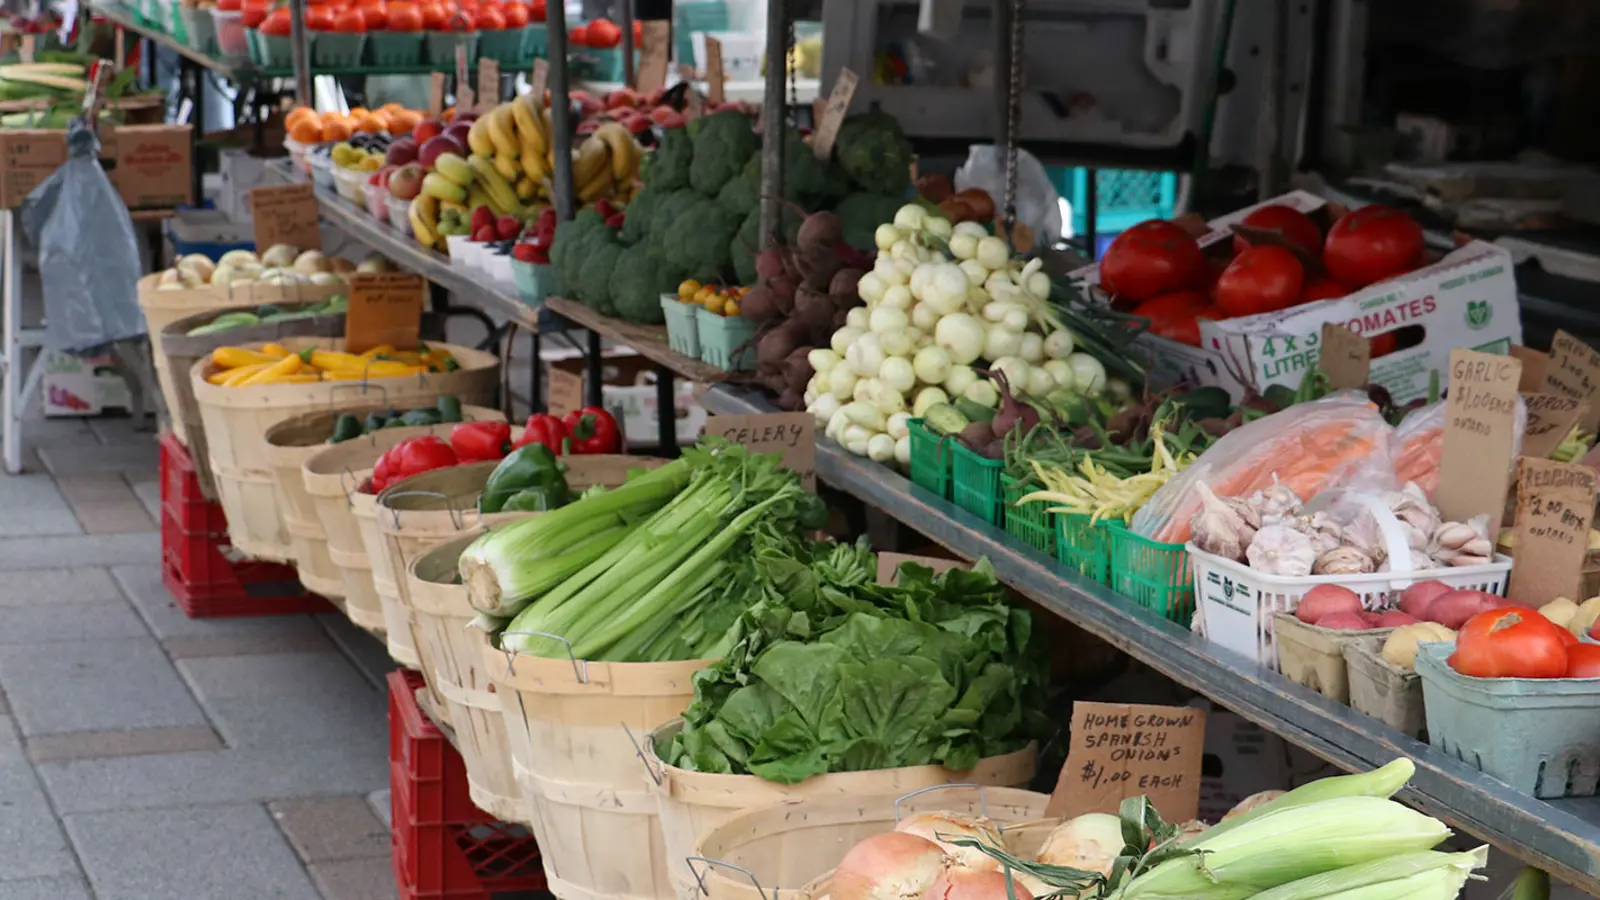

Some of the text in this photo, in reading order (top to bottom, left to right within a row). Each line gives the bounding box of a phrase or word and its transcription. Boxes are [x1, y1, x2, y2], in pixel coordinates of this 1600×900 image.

[1336, 294, 1437, 337] OMATES
[1262, 335, 1276, 358] 4
[1304, 331, 1319, 347] 3
[1263, 347, 1321, 380] LITRE
[1453, 359, 1513, 382] GARLIC
[1083, 712, 1195, 730] HOME GROWN
[1085, 731, 1168, 748] SPANISH
[1081, 759, 1183, 789] $1.00 EACH
